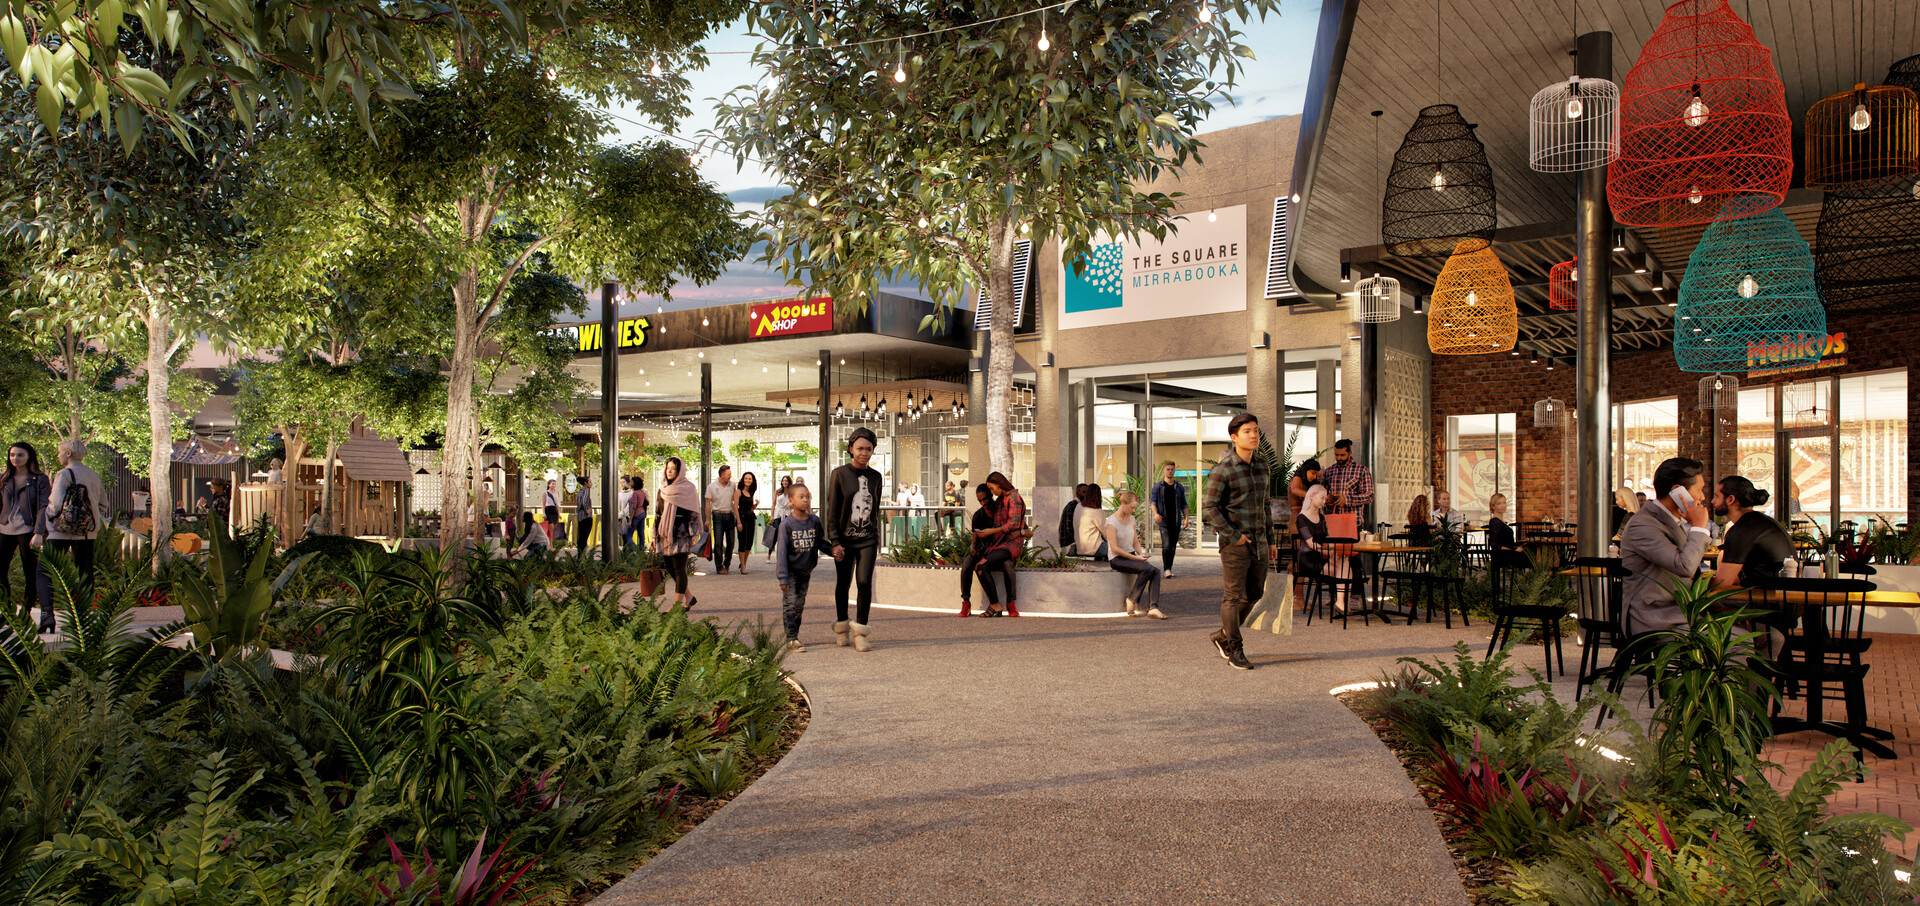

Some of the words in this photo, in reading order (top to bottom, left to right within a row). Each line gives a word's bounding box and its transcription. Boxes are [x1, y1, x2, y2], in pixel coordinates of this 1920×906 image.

[1133, 254, 1161, 269] THE
[1171, 243, 1238, 264] SQUARE
[1132, 263, 1239, 288] MIRRABOOKA
[772, 319, 797, 331] SHOP
[1747, 368, 1780, 379] MEXICAN
[1817, 357, 1846, 369] MEALS
[791, 529, 816, 540] SPACE
[793, 538, 815, 549] CREW
